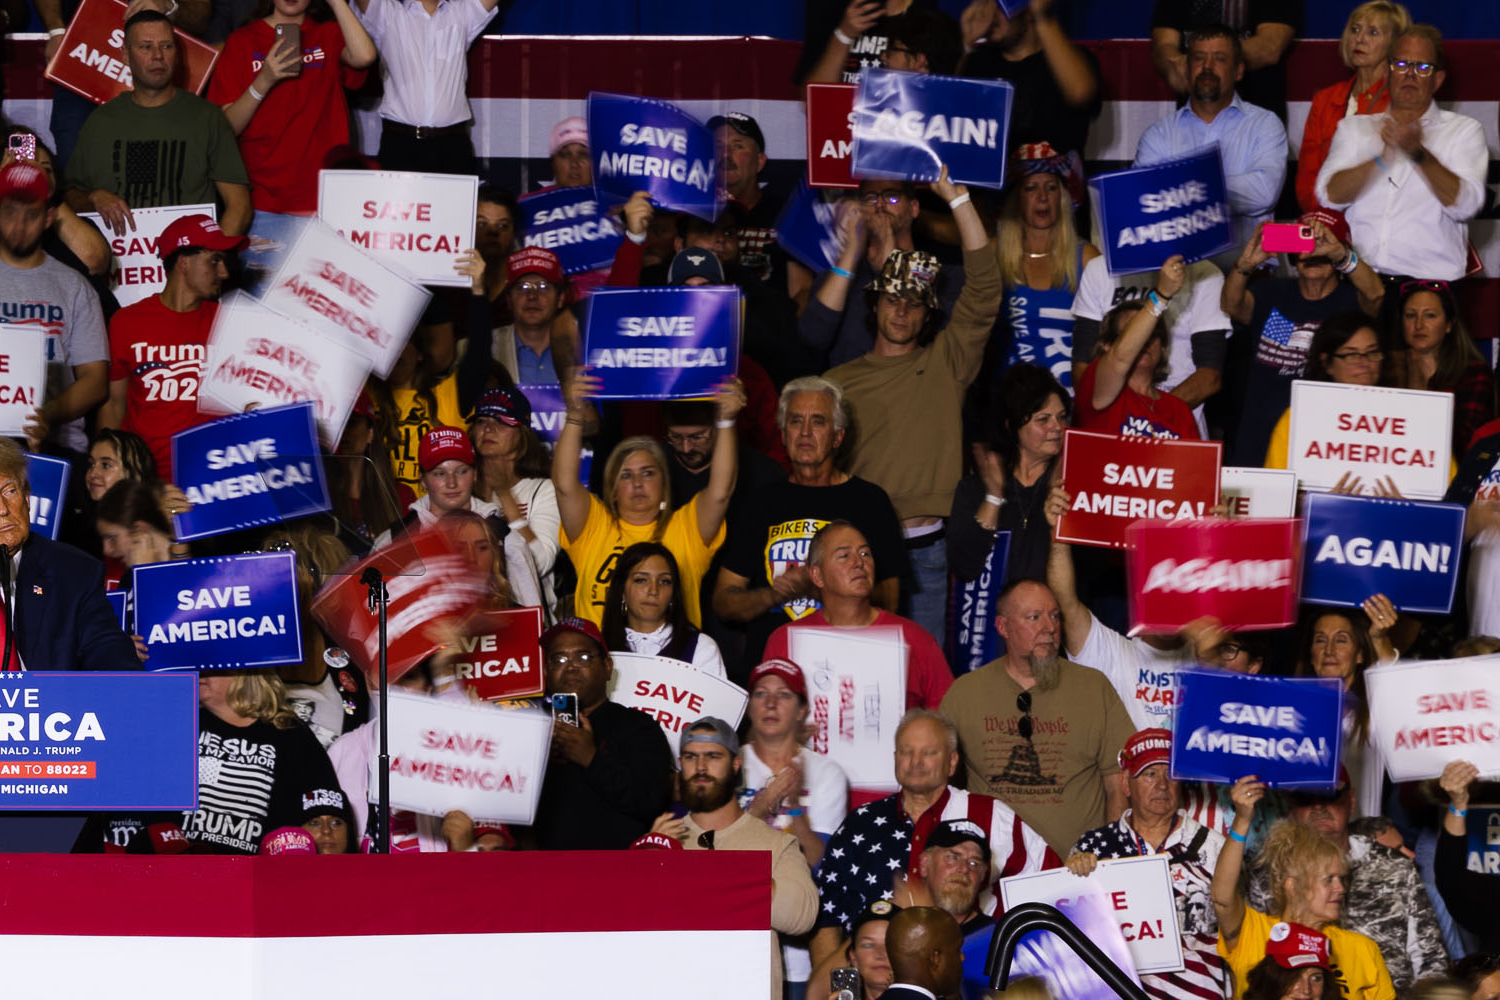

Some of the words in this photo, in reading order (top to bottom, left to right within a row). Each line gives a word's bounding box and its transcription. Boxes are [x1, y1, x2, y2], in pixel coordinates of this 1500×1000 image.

[619, 123, 688, 155] SAVE
[362, 200, 432, 222] SAVE
[532, 200, 599, 226] SAVE
[617, 316, 696, 337] SAVE
[1010, 296, 1030, 339] SAVE
[131, 342, 206, 363] Trum
[594, 347, 727, 368] AMERICA!
[143, 376, 199, 402] 202
[428, 429, 463, 441] Trump
[1337, 413, 1407, 437] SAVE
[206, 437, 279, 470] SAVE
[1304, 440, 1436, 468] AMERICA!
[186, 461, 314, 505] AMERICA!
[1102, 462, 1175, 490] SAVE
[1072, 491, 1206, 522] AMERICA!
[770, 520, 820, 538] BIKERS
[771, 539, 811, 561] TRU
[1314, 534, 1453, 574] AGAIN!
[176, 585, 252, 611] SAVE
[959, 579, 977, 646] SAVE
[147, 614, 287, 646] AMERICA!
[633, 680, 705, 714] SAVE
[1417, 690, 1491, 715] SAVE
[1219, 701, 1305, 733] SAVE
[33, 746, 42, 756] J.
[45, 746, 82, 756] TRUMP
[422, 729, 499, 759] SAVE
[1186, 726, 1330, 767] AMERICA!
[24, 764, 43, 775] TO
[46, 764, 88, 775] 88022
[228, 754, 275, 770] SAVIOR
[1, 784, 69, 795] MICHIGAN
[181, 808, 263, 844] TRUMP
[201, 831, 260, 854] PRESIDENT
